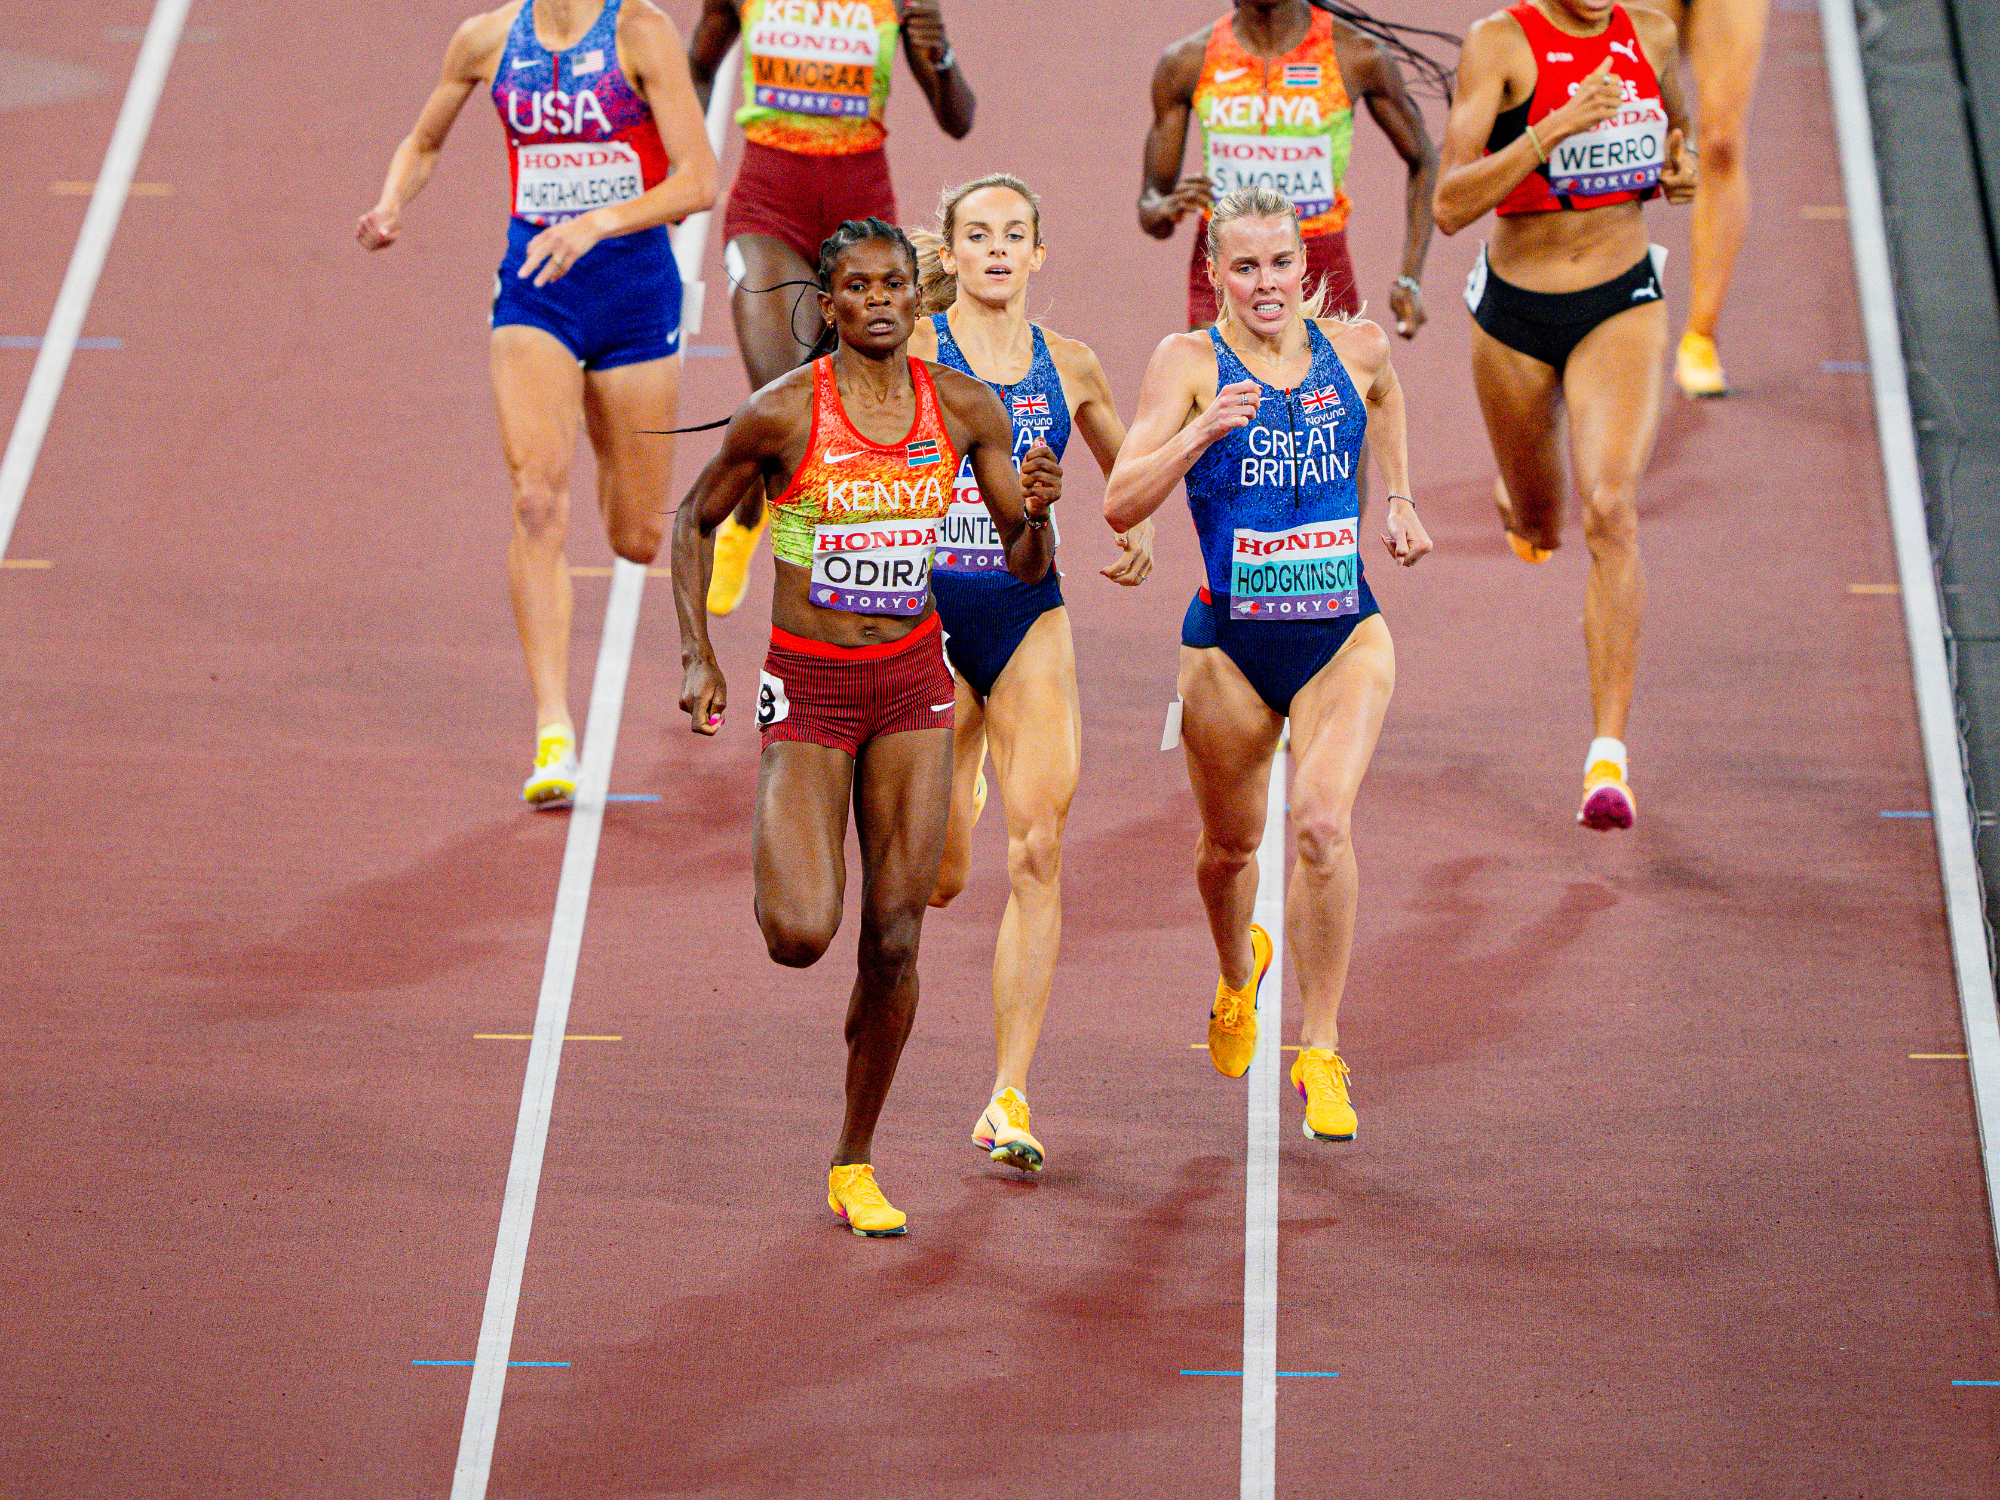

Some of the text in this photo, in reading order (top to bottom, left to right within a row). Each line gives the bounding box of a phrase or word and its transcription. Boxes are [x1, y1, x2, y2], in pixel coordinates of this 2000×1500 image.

[763, 0, 875, 30] KENYA
[756, 31, 872, 55] HONDA
[784, 61, 867, 92] MORAA
[508, 89, 613, 134] USA
[1209, 95, 1322, 127] KENYA
[1586, 109, 1662, 133] NDA
[523, 151, 633, 169] HONDA
[1212, 142, 1325, 161] HONDA
[1560, 134, 1656, 171] WERRO
[522, 175, 638, 208] HURTA-KLECKER
[1236, 171, 1326, 197] MORAA
[1012, 417, 1053, 428] Novuna
[1305, 406, 1346, 428] Novuna
[1248, 421, 1341, 458] GREAT
[1240, 451, 1350, 488] BRITAIN
[827, 479, 944, 512] KENYA
[816, 528, 938, 551] HONDA
[940, 515, 1002, 545] HUNTE
[1236, 528, 1356, 557] HONDA
[824, 556, 928, 588] ODIRA
[962, 554, 1004, 567] TOK
